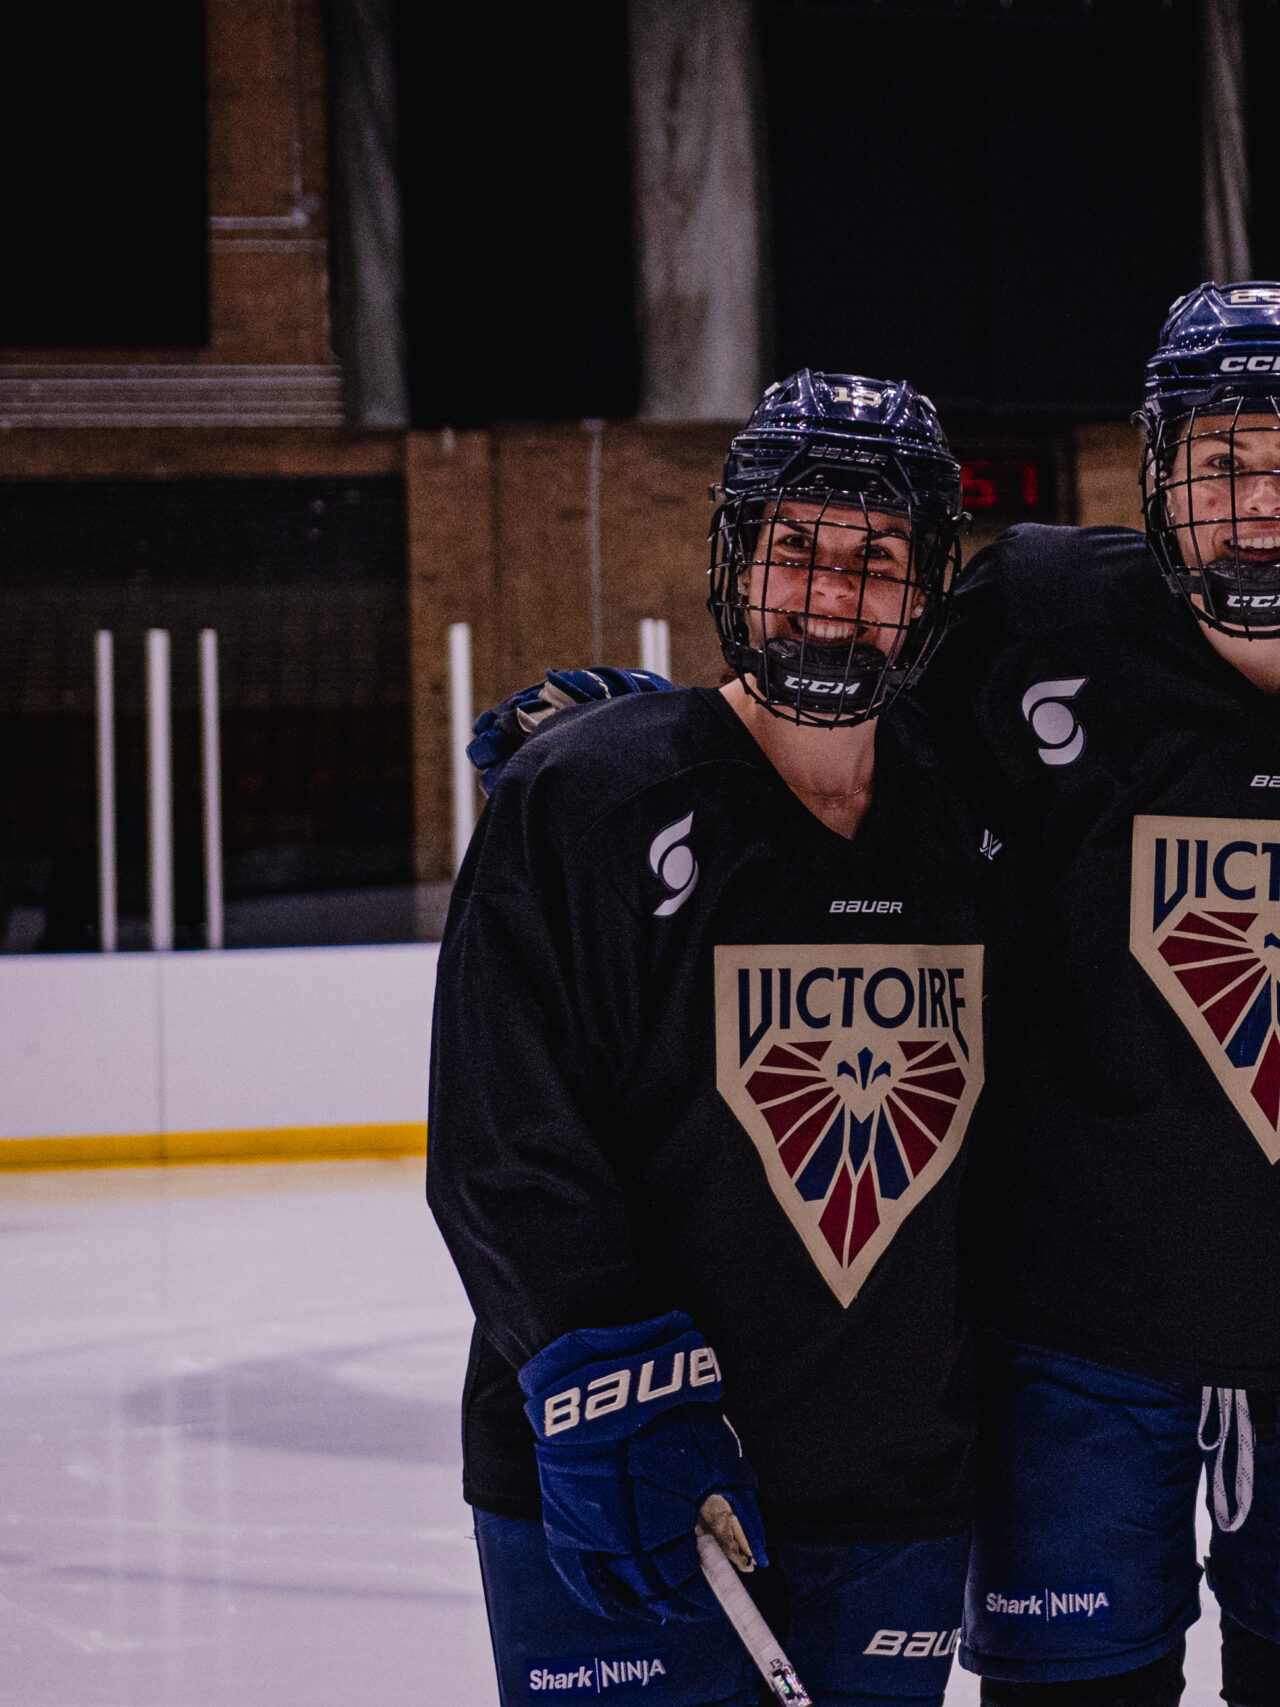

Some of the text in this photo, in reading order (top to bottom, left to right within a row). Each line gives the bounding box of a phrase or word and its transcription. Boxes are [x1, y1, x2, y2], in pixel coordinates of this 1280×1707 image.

[784, 675, 860, 695] CCM
[829, 900, 903, 914] BAUER
[738, 967, 969, 1069] VICTOIRE
[863, 1627, 962, 1658] BAU
